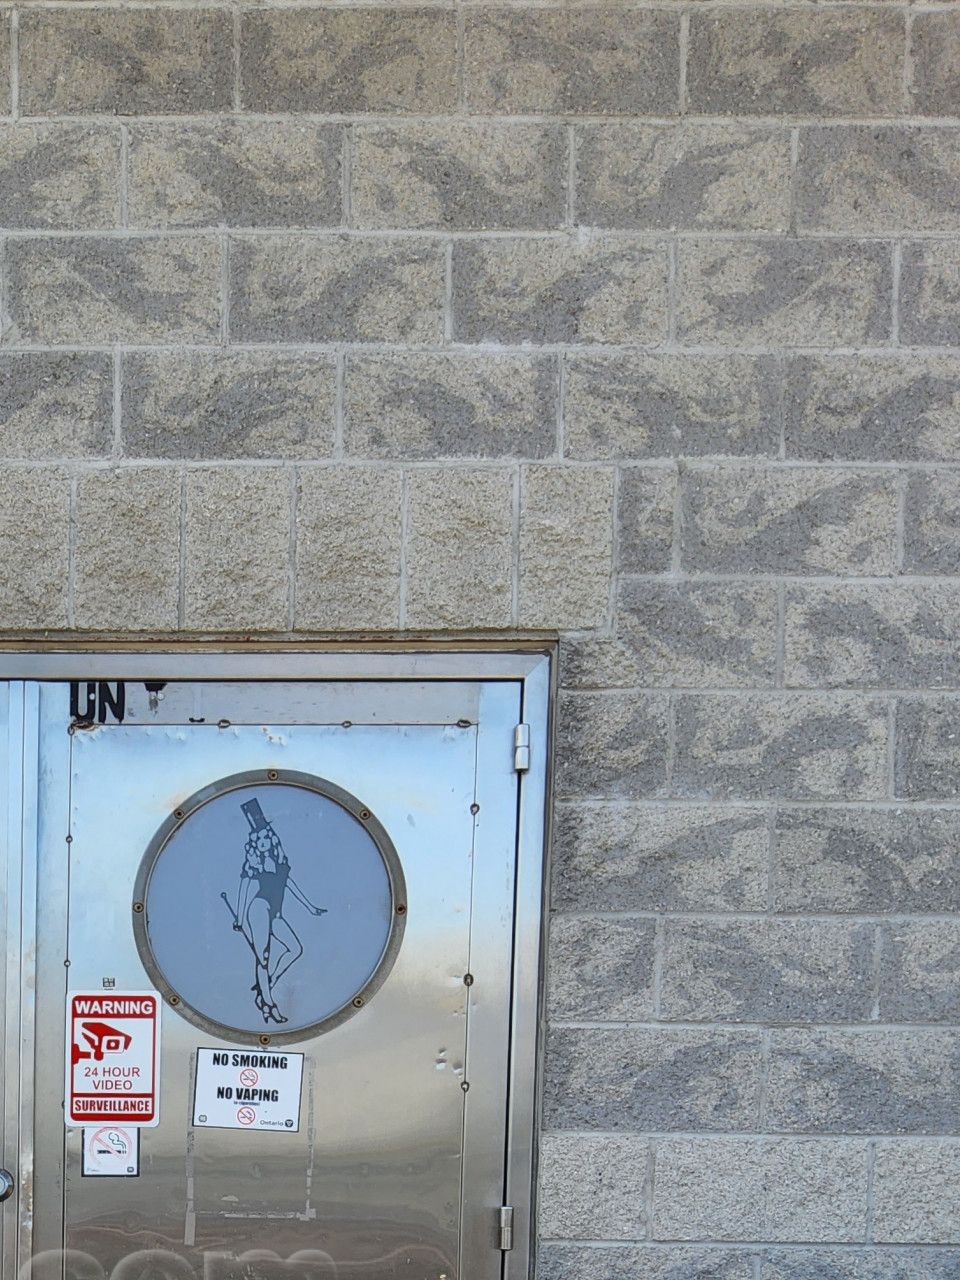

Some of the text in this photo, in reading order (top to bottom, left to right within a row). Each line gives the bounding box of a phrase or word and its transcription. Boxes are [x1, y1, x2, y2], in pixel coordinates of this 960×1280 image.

[75, 1001, 154, 1015] WARNING
[212, 1053, 288, 1069] NO SMOKING
[84, 1067, 140, 1077] 24 HOUR
[92, 1080, 133, 1090] VIDEO
[216, 1087, 279, 1102] NO VAPING
[74, 1099, 150, 1112] SURVEILLANCE
[260, 1119, 284, 1127] Ontario
